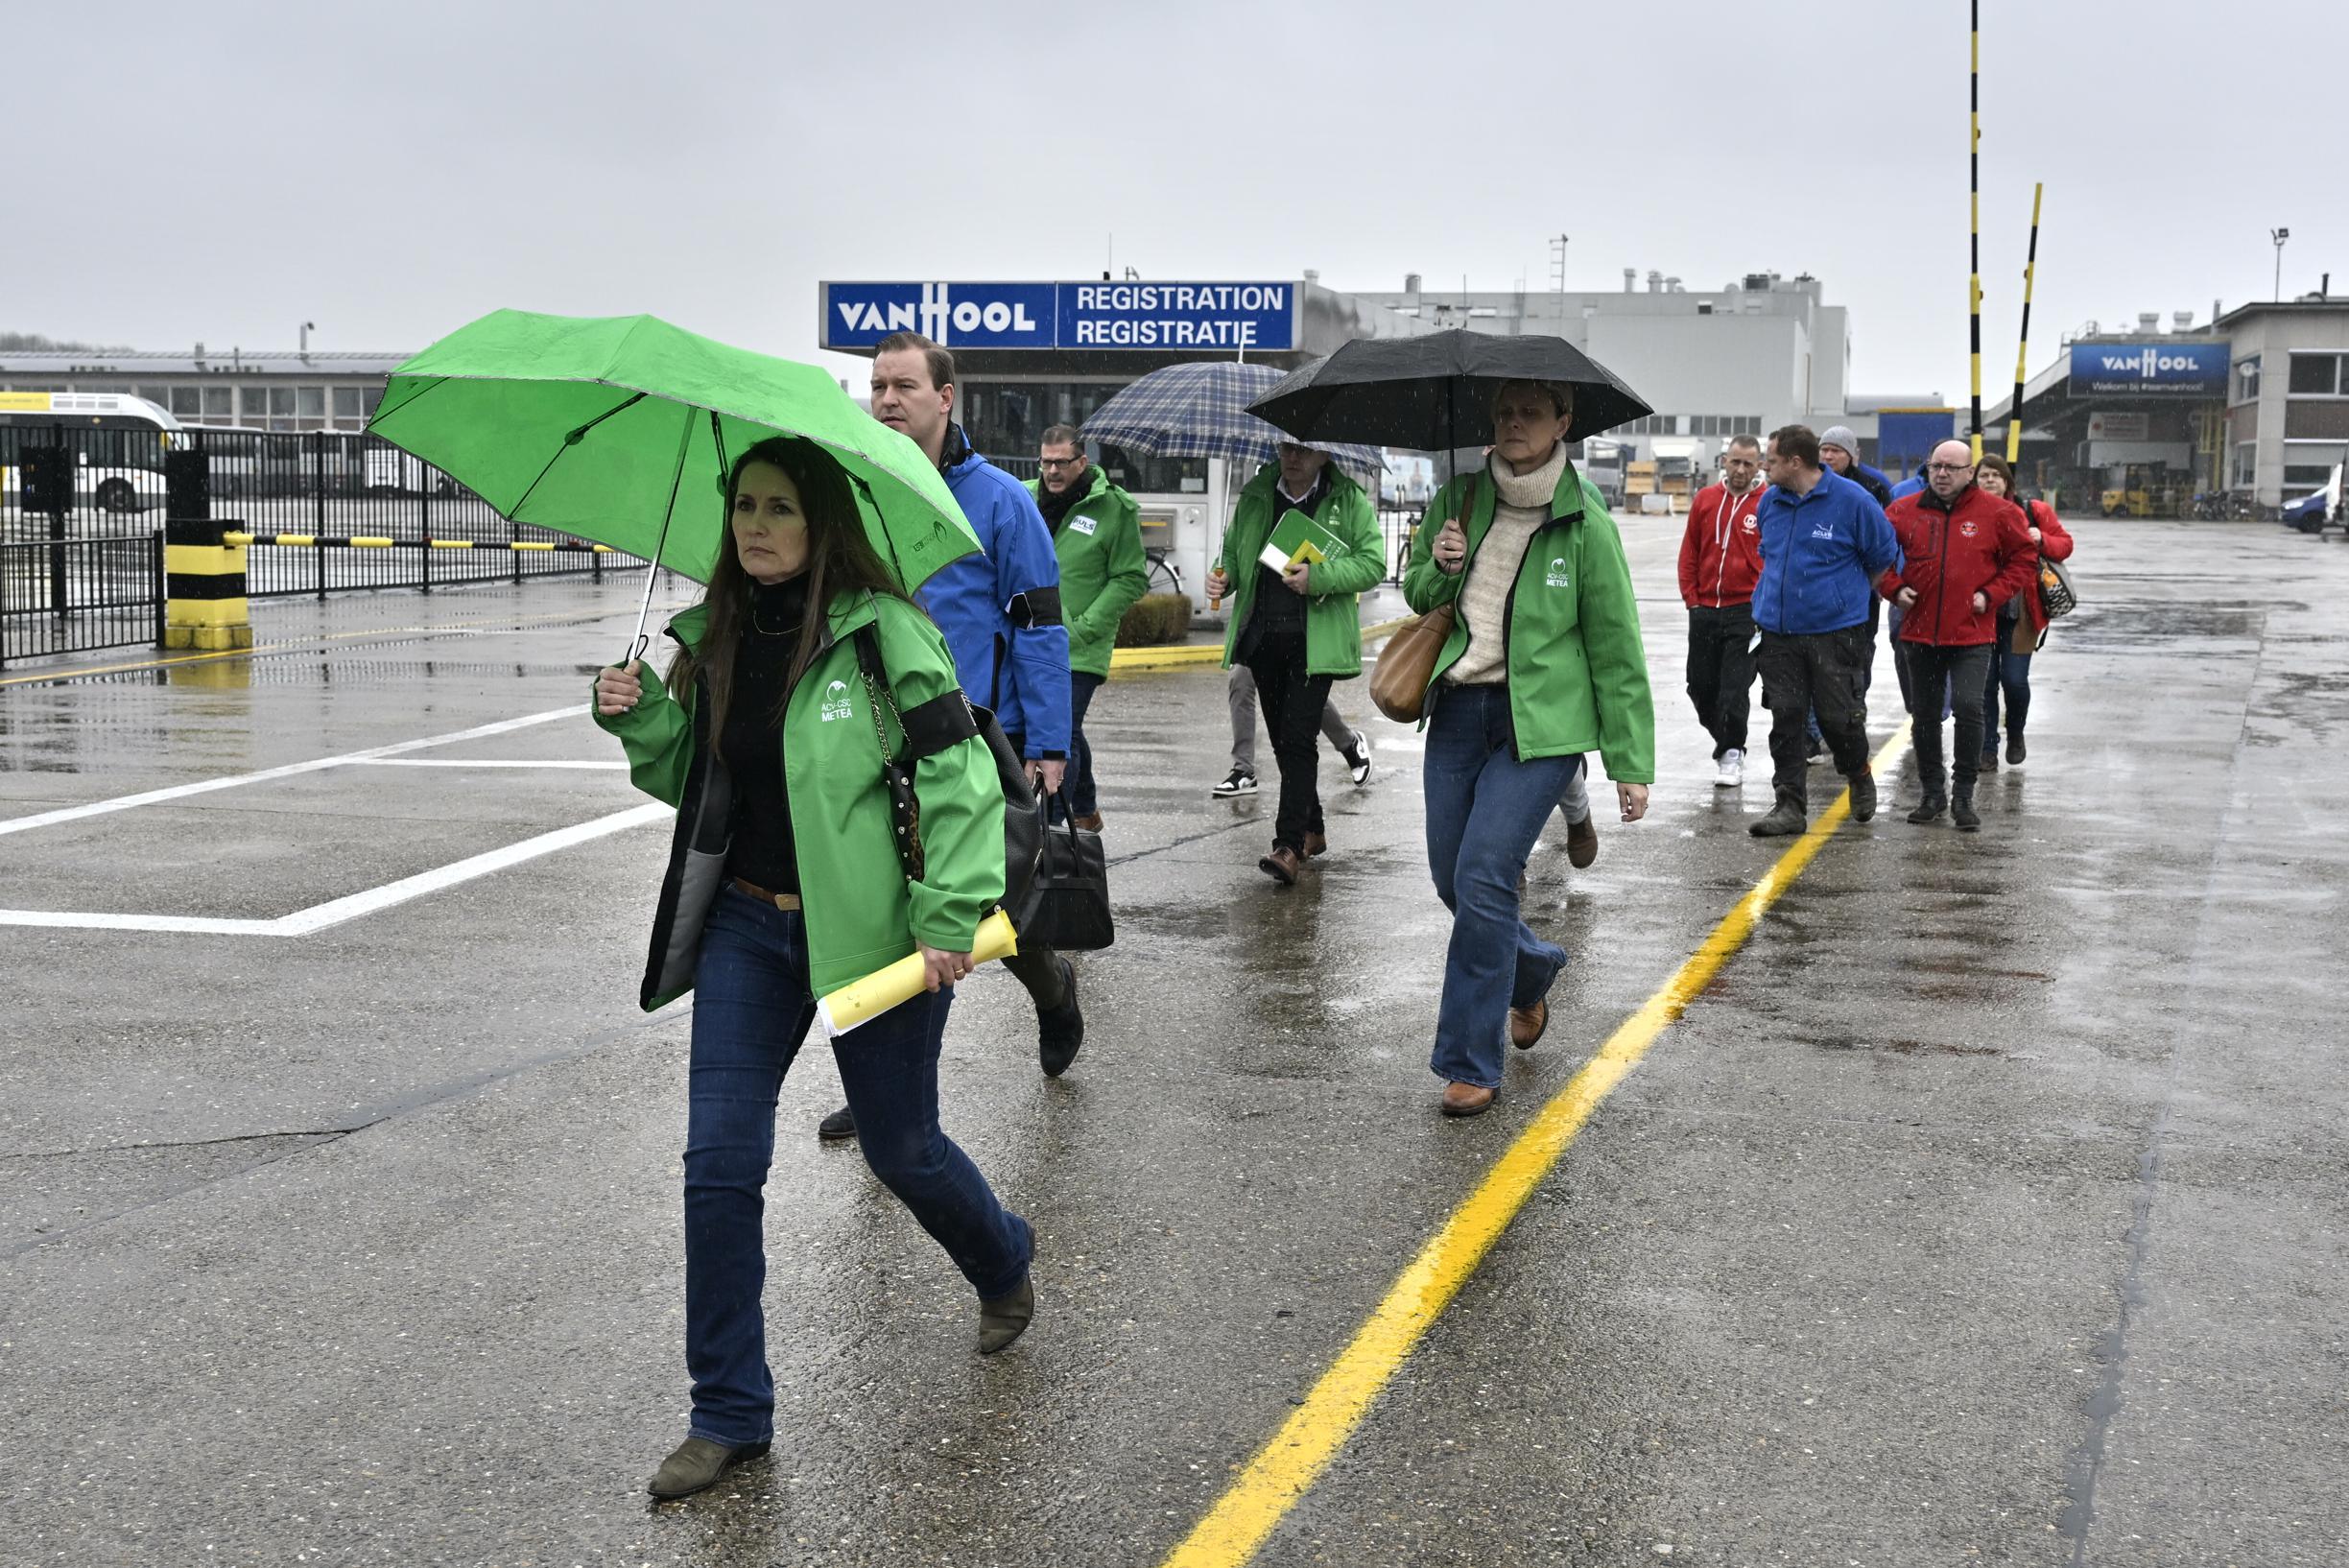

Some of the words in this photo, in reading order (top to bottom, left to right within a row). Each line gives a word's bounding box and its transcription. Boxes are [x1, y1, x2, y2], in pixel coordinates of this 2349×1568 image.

[1076, 286, 1284, 311] REGISTRATION
[1076, 320, 1258, 344] REGISTRATIE
[1546, 579, 1569, 587] METEA
[821, 699, 851, 711] ACV-CSC
[821, 708, 853, 723] METEA
